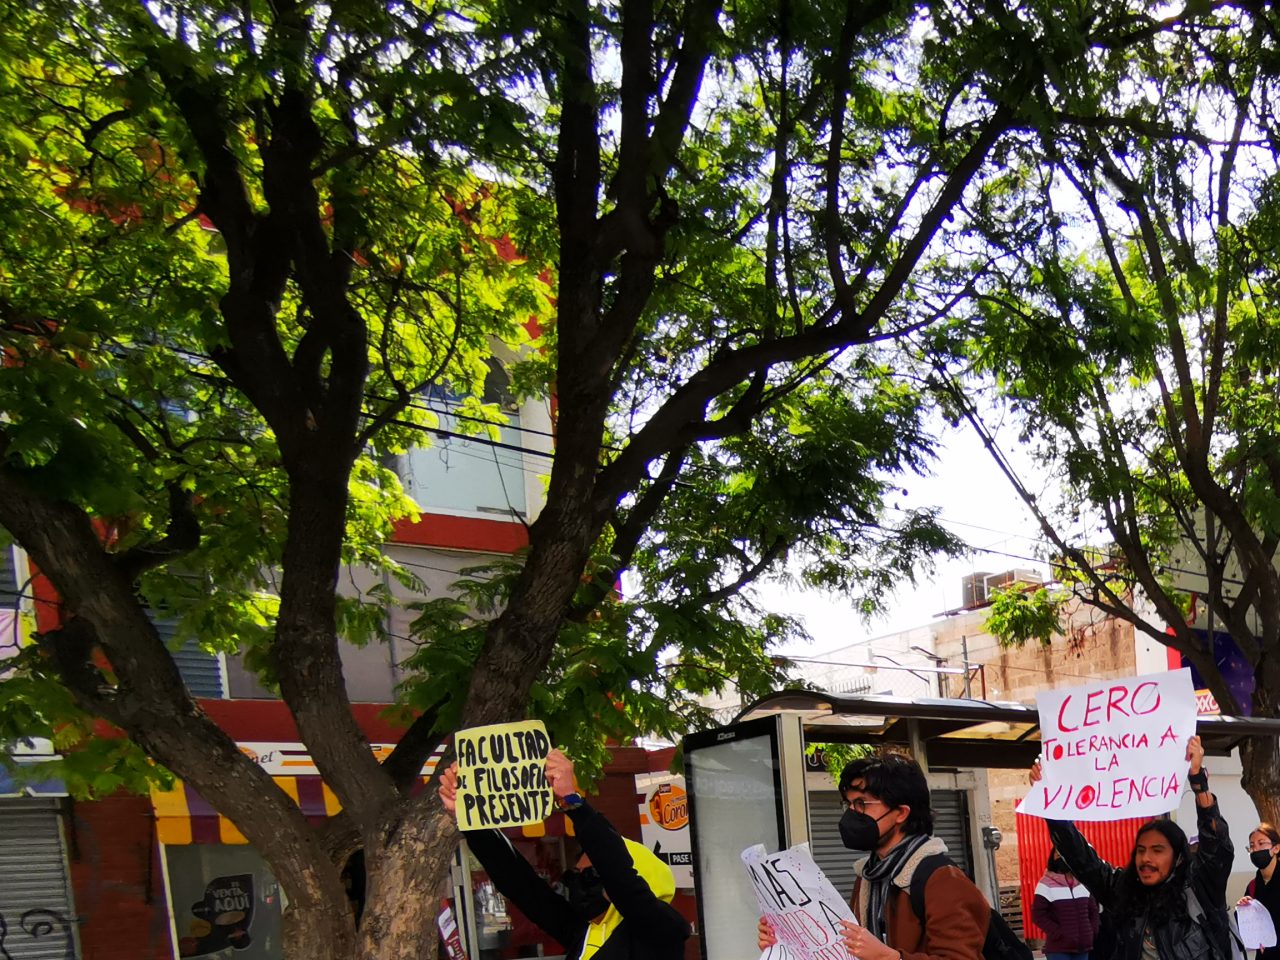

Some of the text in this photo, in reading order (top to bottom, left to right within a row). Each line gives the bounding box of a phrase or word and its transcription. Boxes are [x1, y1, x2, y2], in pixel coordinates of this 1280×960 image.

[1057, 681, 1161, 733] CERO
[1195, 693, 1220, 712] XXO
[458, 729, 549, 768] FACULTAD
[1043, 725, 1179, 762] TOLERANCIA A
[1094, 752, 1120, 771] LA
[463, 790, 550, 826] PRESENTE
[1043, 772, 1180, 811] VIOLENCIA
[663, 803, 688, 824] Coro
[672, 854, 689, 863] PASE
